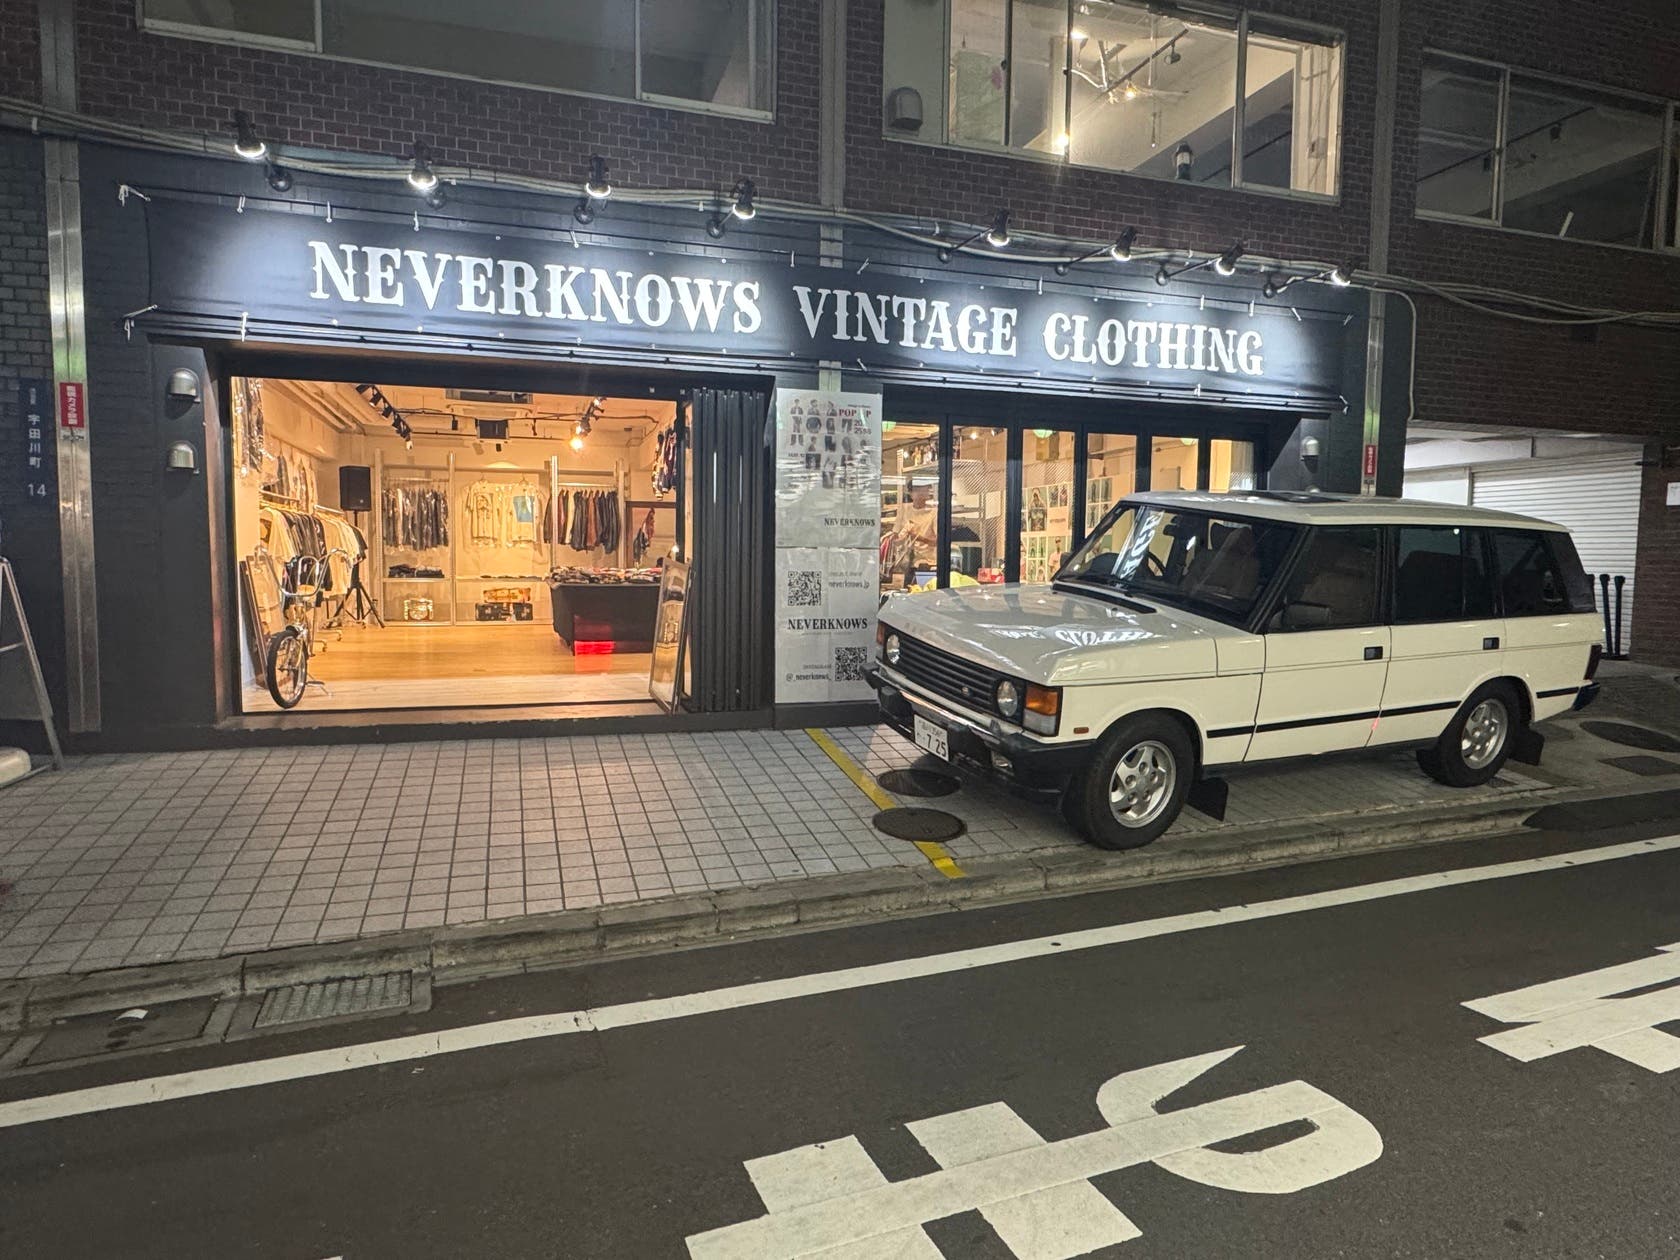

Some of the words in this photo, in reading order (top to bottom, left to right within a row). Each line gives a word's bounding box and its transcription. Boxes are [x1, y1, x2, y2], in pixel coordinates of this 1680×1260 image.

[308, 241, 763, 334] NEVERKNOWS
[792, 286, 1018, 358] VINTAGE
[1041, 312, 1264, 376] CLOTHING
[28, 483, 47, 497] 14
[824, 518, 876, 527] NEVERKNOWS
[787, 617, 869, 630] NEVERKNOWS
